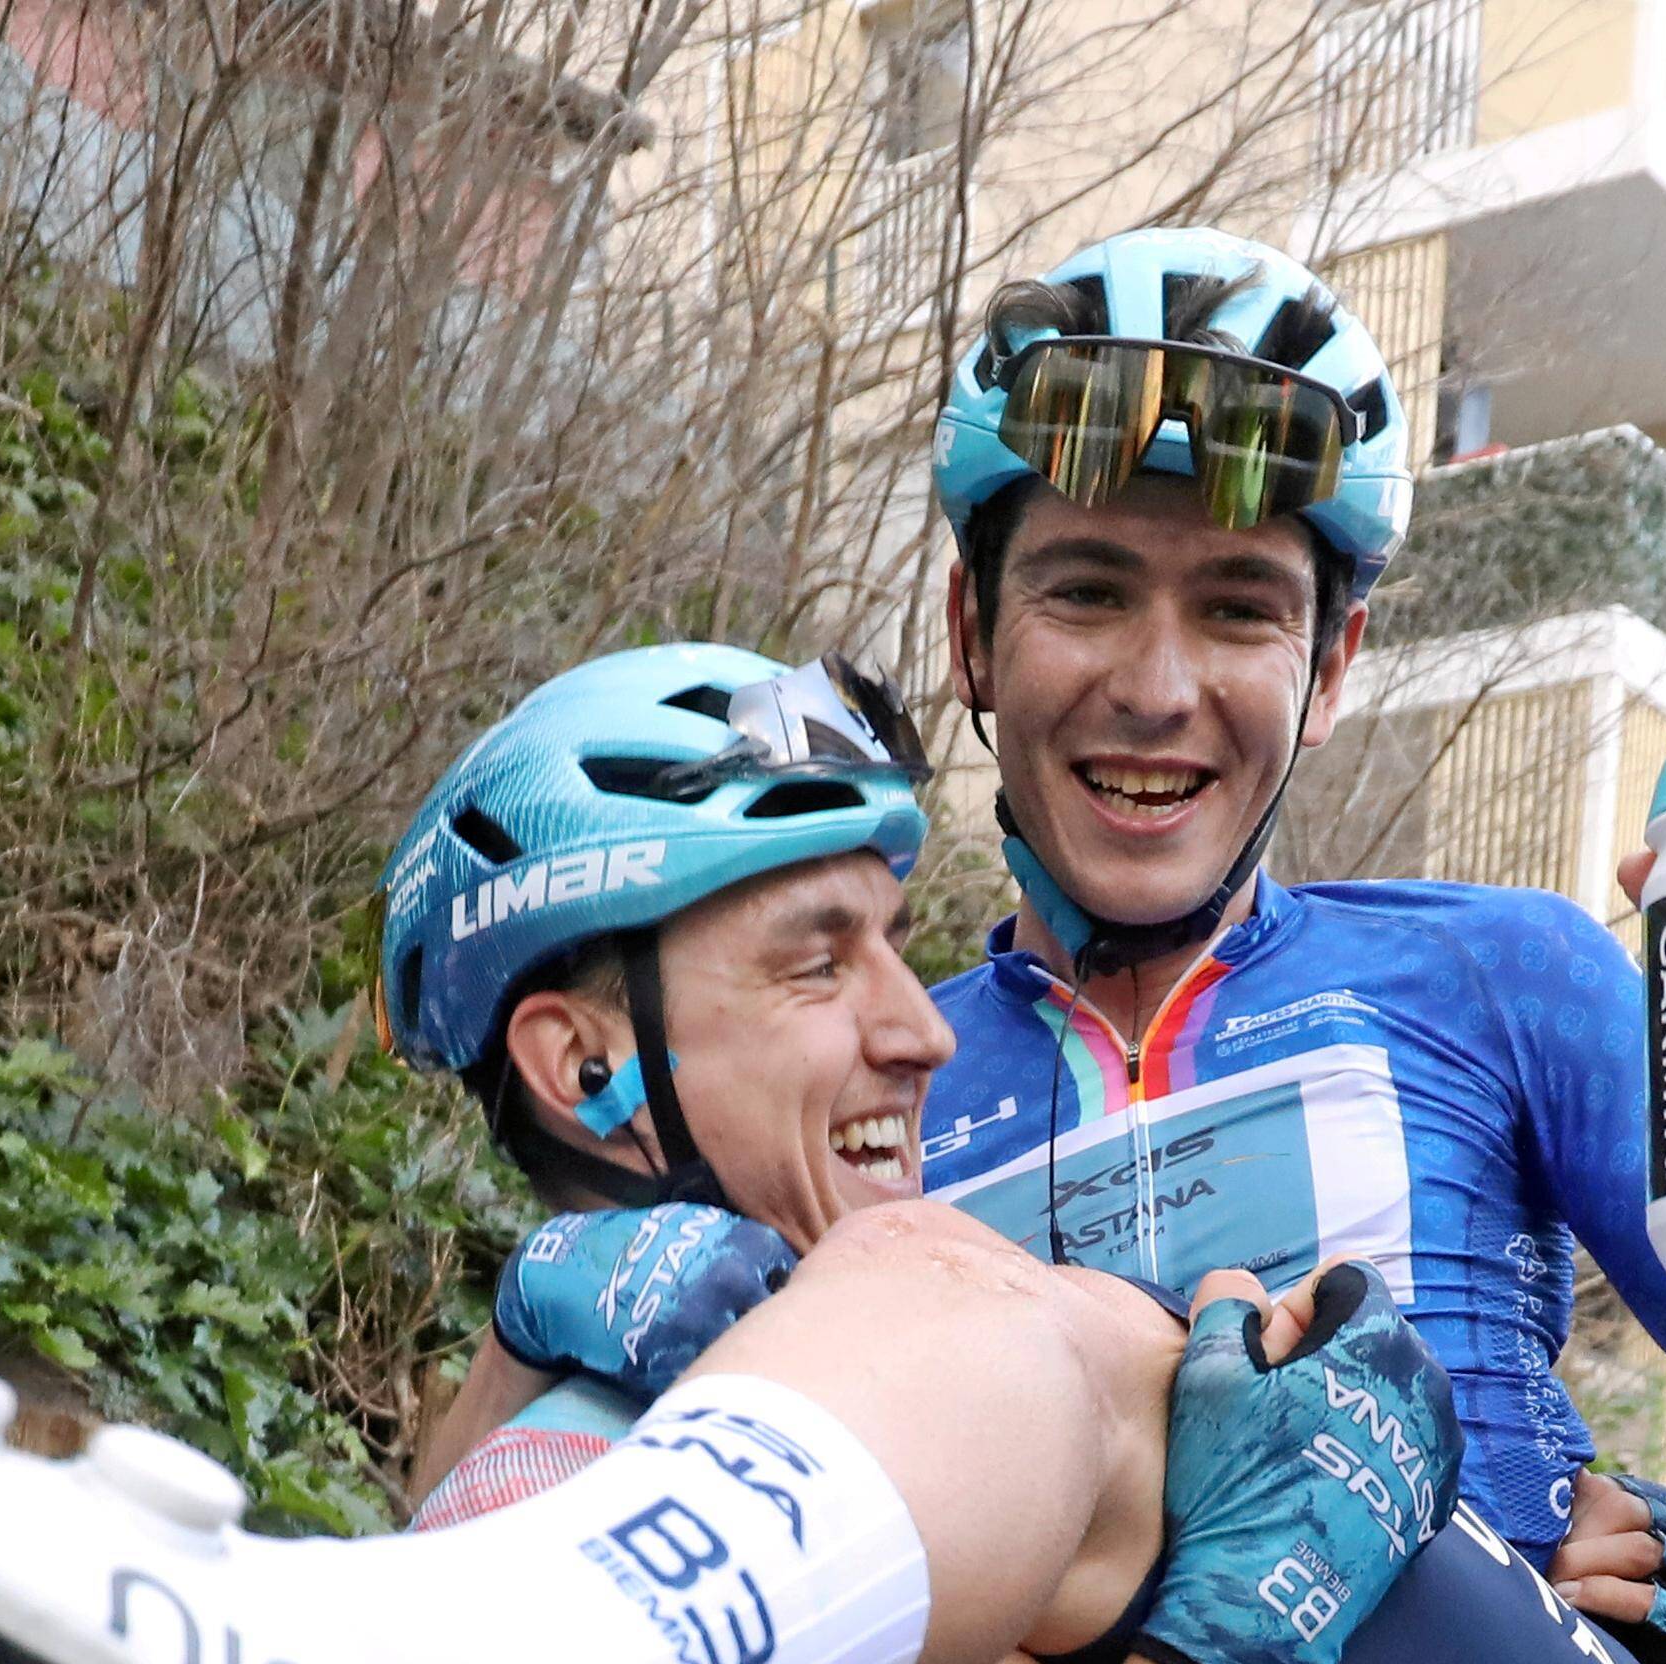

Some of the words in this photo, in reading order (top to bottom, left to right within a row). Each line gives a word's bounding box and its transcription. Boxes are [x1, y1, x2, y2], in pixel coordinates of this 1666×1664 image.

[1060, 1177, 1218, 1251] ASTANA
[1104, 1225, 1166, 1257] TEAM
[1323, 1365, 1436, 1546] ASTANA
[1256, 1556, 1341, 1644] B3
[1291, 1539, 1353, 1602] BIEMME
